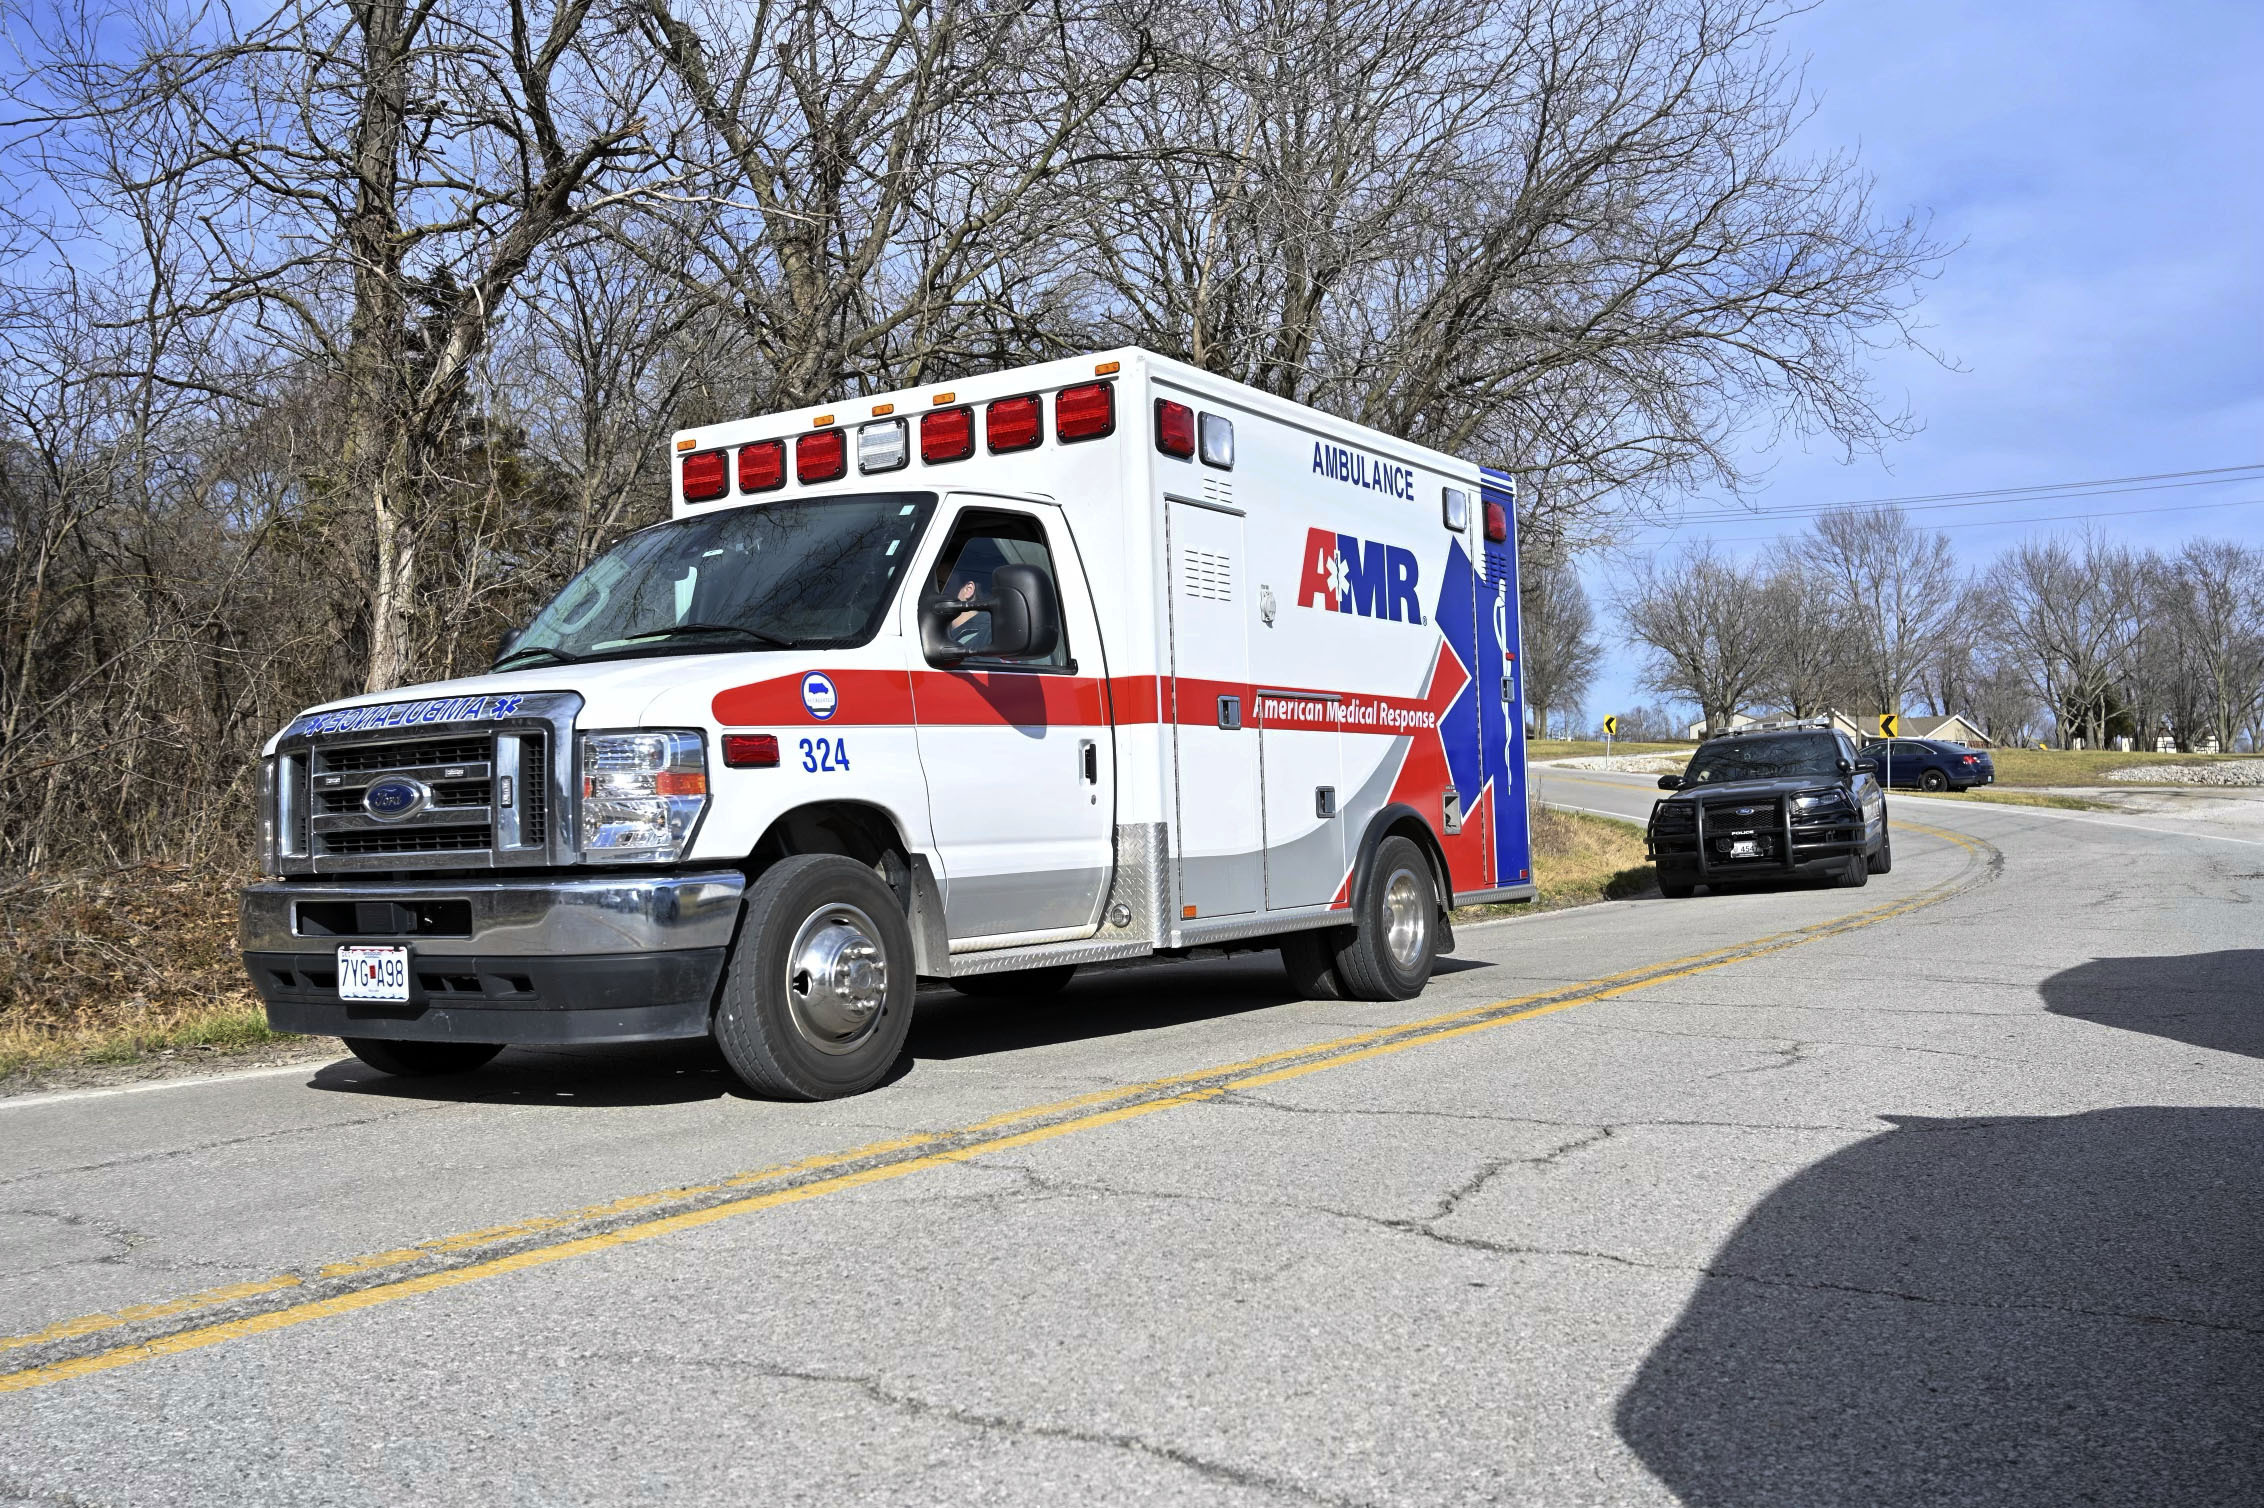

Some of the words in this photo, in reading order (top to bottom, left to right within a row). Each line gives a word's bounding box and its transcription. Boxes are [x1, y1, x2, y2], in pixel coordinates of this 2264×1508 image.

[1312, 441, 1415, 501] AMBULANCE
[1297, 526, 1422, 625] AMR
[1252, 694, 1323, 722] American
[1325, 698, 1377, 725] Medical
[1379, 702, 1435, 733] Response
[799, 737, 850, 773] 324
[375, 792, 401, 806] Ford
[341, 959, 369, 988] 7YG
[377, 959, 404, 988] A98
